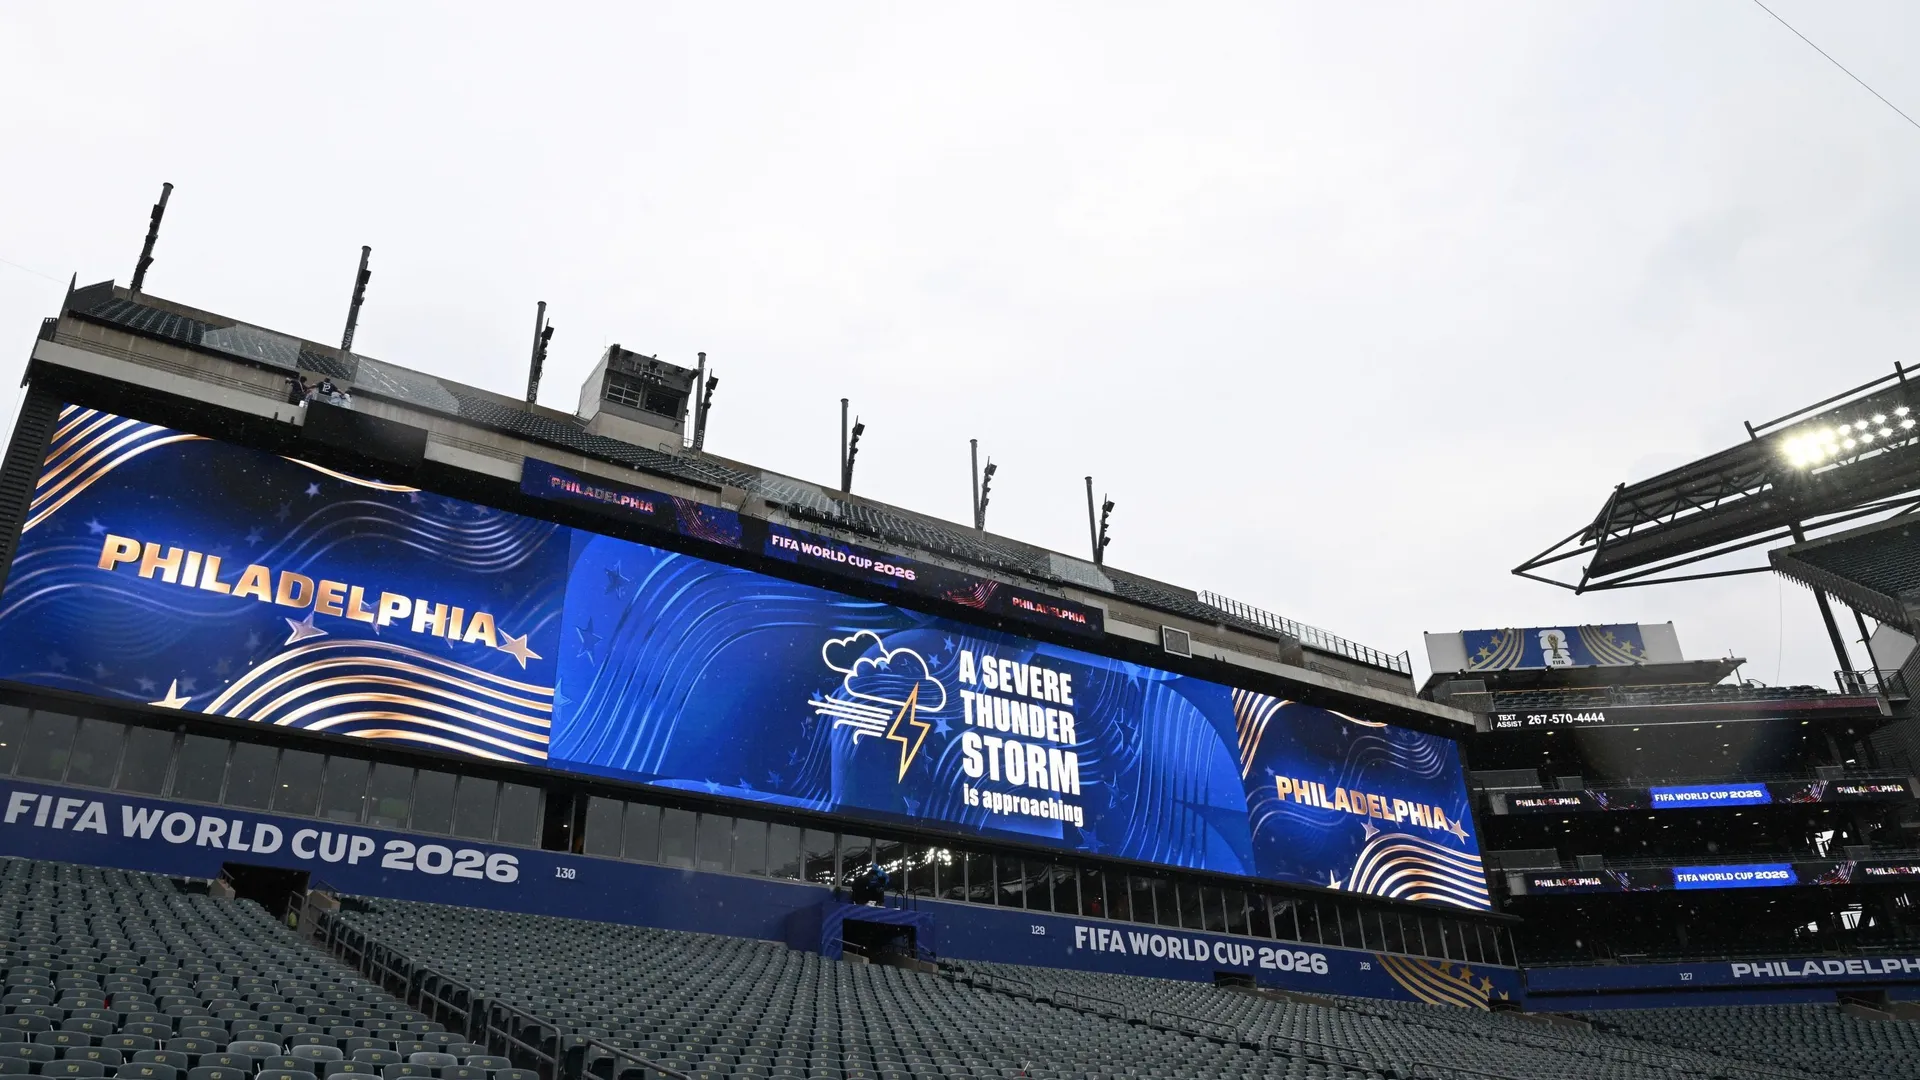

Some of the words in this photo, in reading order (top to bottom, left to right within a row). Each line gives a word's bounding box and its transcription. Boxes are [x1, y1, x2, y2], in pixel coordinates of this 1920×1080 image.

[550, 476, 654, 513] PHILADELPHIA
[771, 534, 800, 552] FIFA
[801, 542, 846, 563] WORLD
[848, 554, 873, 569] CUP
[873, 561, 916, 581] 2026
[97, 533, 498, 648] PHILADELPHIA
[958, 649, 977, 685] A
[982, 655, 1074, 706] SEVERE
[959, 689, 1076, 745] THUNDER
[1526, 712, 1605, 725] 267-570-4444
[961, 732, 1081, 796] STORM
[963, 783, 979, 807] is
[982, 789, 1084, 828] approaching
[1275, 775, 1449, 831] PHILADELPHIA
[1515, 797, 1581, 807] PHILADELPHIA
[1654, 793, 1675, 802] FIFA
[1675, 792, 1709, 801] WORLD
[1710, 790, 1729, 799] CUP
[1729, 789, 1763, 798] 2026
[3, 791, 108, 835] FIFA
[121, 805, 284, 854] WORLD
[291, 828, 376, 865] CUP
[381, 839, 520, 884] 2026
[555, 866, 576, 880] 130
[1534, 877, 1602, 888] PHILADELPHIA
[1677, 874, 1699, 883] FIFA
[1699, 872, 1734, 882] WORLD
[1734, 871, 1754, 880] CUP
[1754, 870, 1789, 880] 2026
[1031, 924, 1046, 936] 129
[1074, 925, 1127, 954] FIFA
[1128, 931, 1210, 962] WORLD
[1213, 941, 1255, 967] CUP
[1259, 947, 1329, 975] 2026
[1359, 961, 1371, 971] 128
[1679, 972, 1693, 981] 127
[1731, 958, 1920, 978] PHILADELPH
